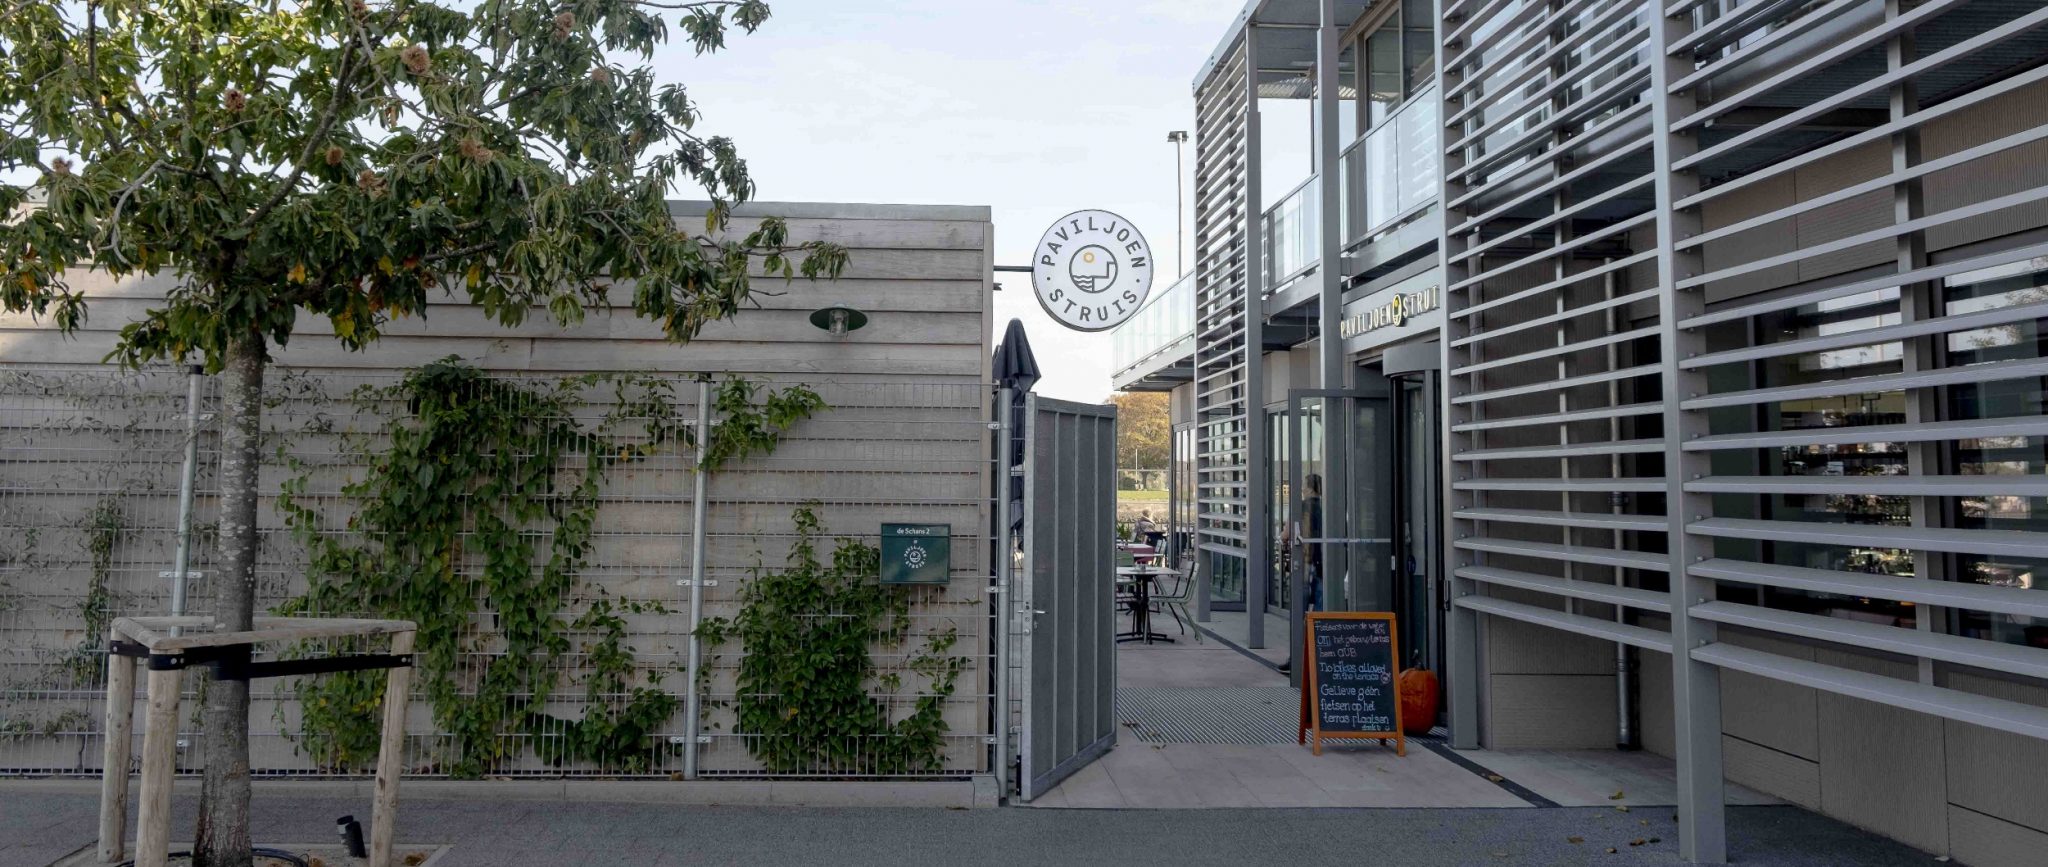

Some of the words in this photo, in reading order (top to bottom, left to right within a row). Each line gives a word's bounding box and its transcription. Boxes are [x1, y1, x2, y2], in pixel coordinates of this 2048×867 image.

[1041, 217, 1146, 268] PAVILJOEN
[1049, 288, 1137, 321] STRUIS
[1340, 303, 1391, 340] PAVILJOEN
[1403, 285, 1439, 318] STRUI
[1358, 662, 1386, 674] allowed
[1320, 684, 1357, 696] Gelieve
[1320, 698, 1350, 711] fietsen
[1351, 703, 1363, 714] op
[1363, 701, 1376, 711] het
[1323, 712, 1350, 723] terras
[1352, 713, 1389, 728] plaatsen
